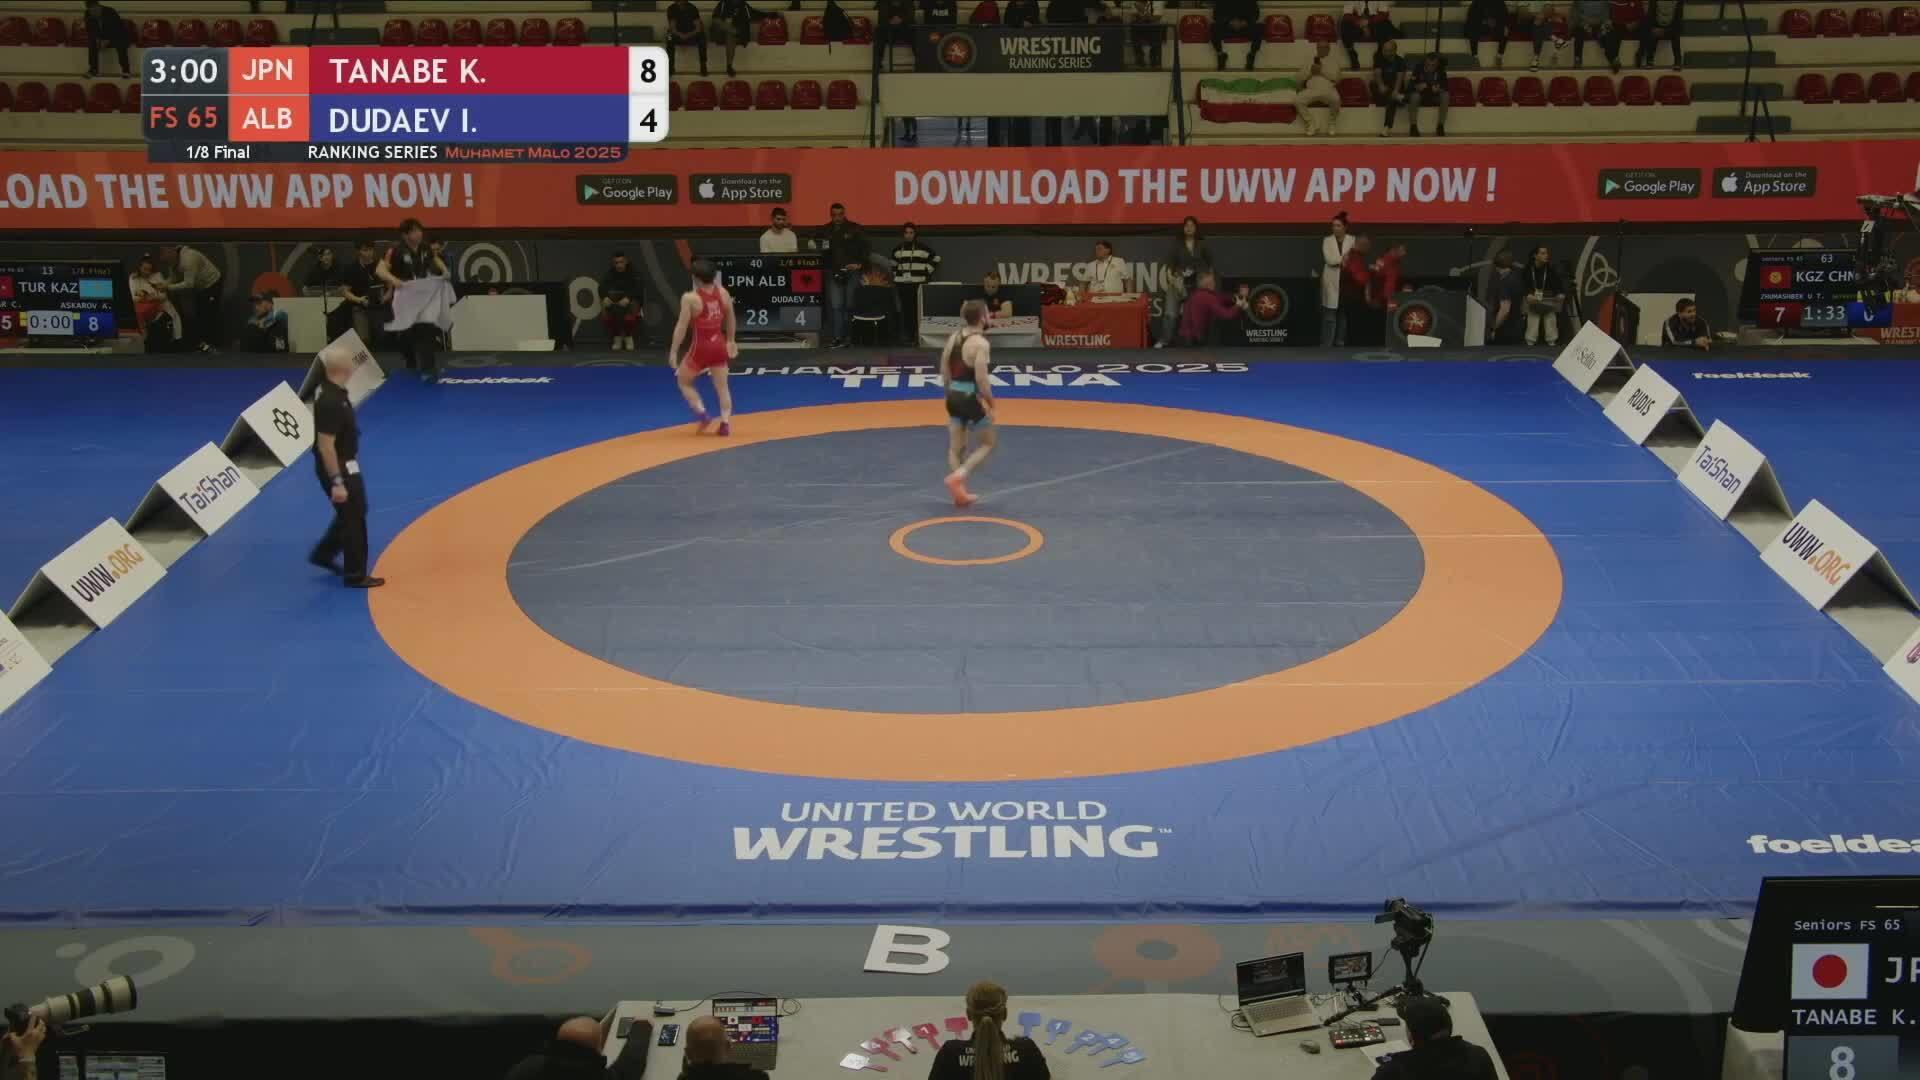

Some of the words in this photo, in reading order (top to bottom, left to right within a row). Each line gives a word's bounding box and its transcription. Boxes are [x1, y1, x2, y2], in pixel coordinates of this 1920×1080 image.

[1000, 36, 1101, 55] WRESTLING
[1009, 57, 1055, 69] RANKING
[1058, 57, 1092, 69] SERIES
[95, 174, 169, 209] THE
[178, 174, 273, 209] UWW
[286, 174, 353, 209] APP
[364, 173, 451, 209] NOW
[463, 173, 474, 208] !
[603, 187, 643, 201] Google
[647, 187, 673, 200] Play
[721, 187, 748, 200] App
[750, 186, 783, 198] Store
[894, 168, 1110, 206] DOWNLOAD
[1119, 167, 1188, 204] THE
[1200, 167, 1297, 204] UWW
[1303, 167, 1376, 203] APP
[1386, 167, 1477, 203] NOW
[1486, 167, 1497, 202] !
[1624, 181, 1666, 195] Google
[1669, 180, 1695, 194] Play
[1744, 181, 1771, 195] App
[1772, 181, 1807, 192] Store
[749, 259, 763, 268] 40
[1821, 254, 1833, 263] 63
[41, 266, 54, 275] 13
[1796, 271, 1824, 282] KGZ
[1829, 271, 1856, 282] CHN
[18, 281, 46, 293] TUR
[51, 282, 79, 293] KAZ
[727, 275, 754, 287] JPN
[758, 275, 786, 287] ALB
[771, 295, 804, 303] DUDAEV
[746, 309, 769, 325] 28
[794, 310, 807, 326] 4
[1774, 306, 1787, 323] 7
[1804, 305, 1846, 320] 1:33
[1, 315, 12, 330] 5
[30, 315, 71, 329] 0:00
[88, 316, 99, 332] 8
[1044, 334, 1111, 346] WRESTLING
[1246, 328, 1288, 337] WRESTLING
[1097, 363, 1249, 373] 2025
[1627, 387, 1656, 417] RUDIS
[1696, 445, 1741, 494] TaiShan
[179, 466, 241, 515] TaiShan
[1782, 522, 1851, 586] UWW.ORG
[70, 543, 145, 602] UWW.ORG
[781, 801, 937, 822] UNITED
[948, 800, 1108, 821] WORLD
[733, 824, 1159, 861] WRESTLING
[1793, 919, 1851, 931] Seniors
[1860, 920, 1876, 930] FS
[1884, 919, 1901, 931] 65
[864, 924, 951, 974] B
[1791, 1009, 1877, 1025] TANABE
[1892, 1009, 1916, 1025] K.
[1829, 1046, 1856, 1080] 8
